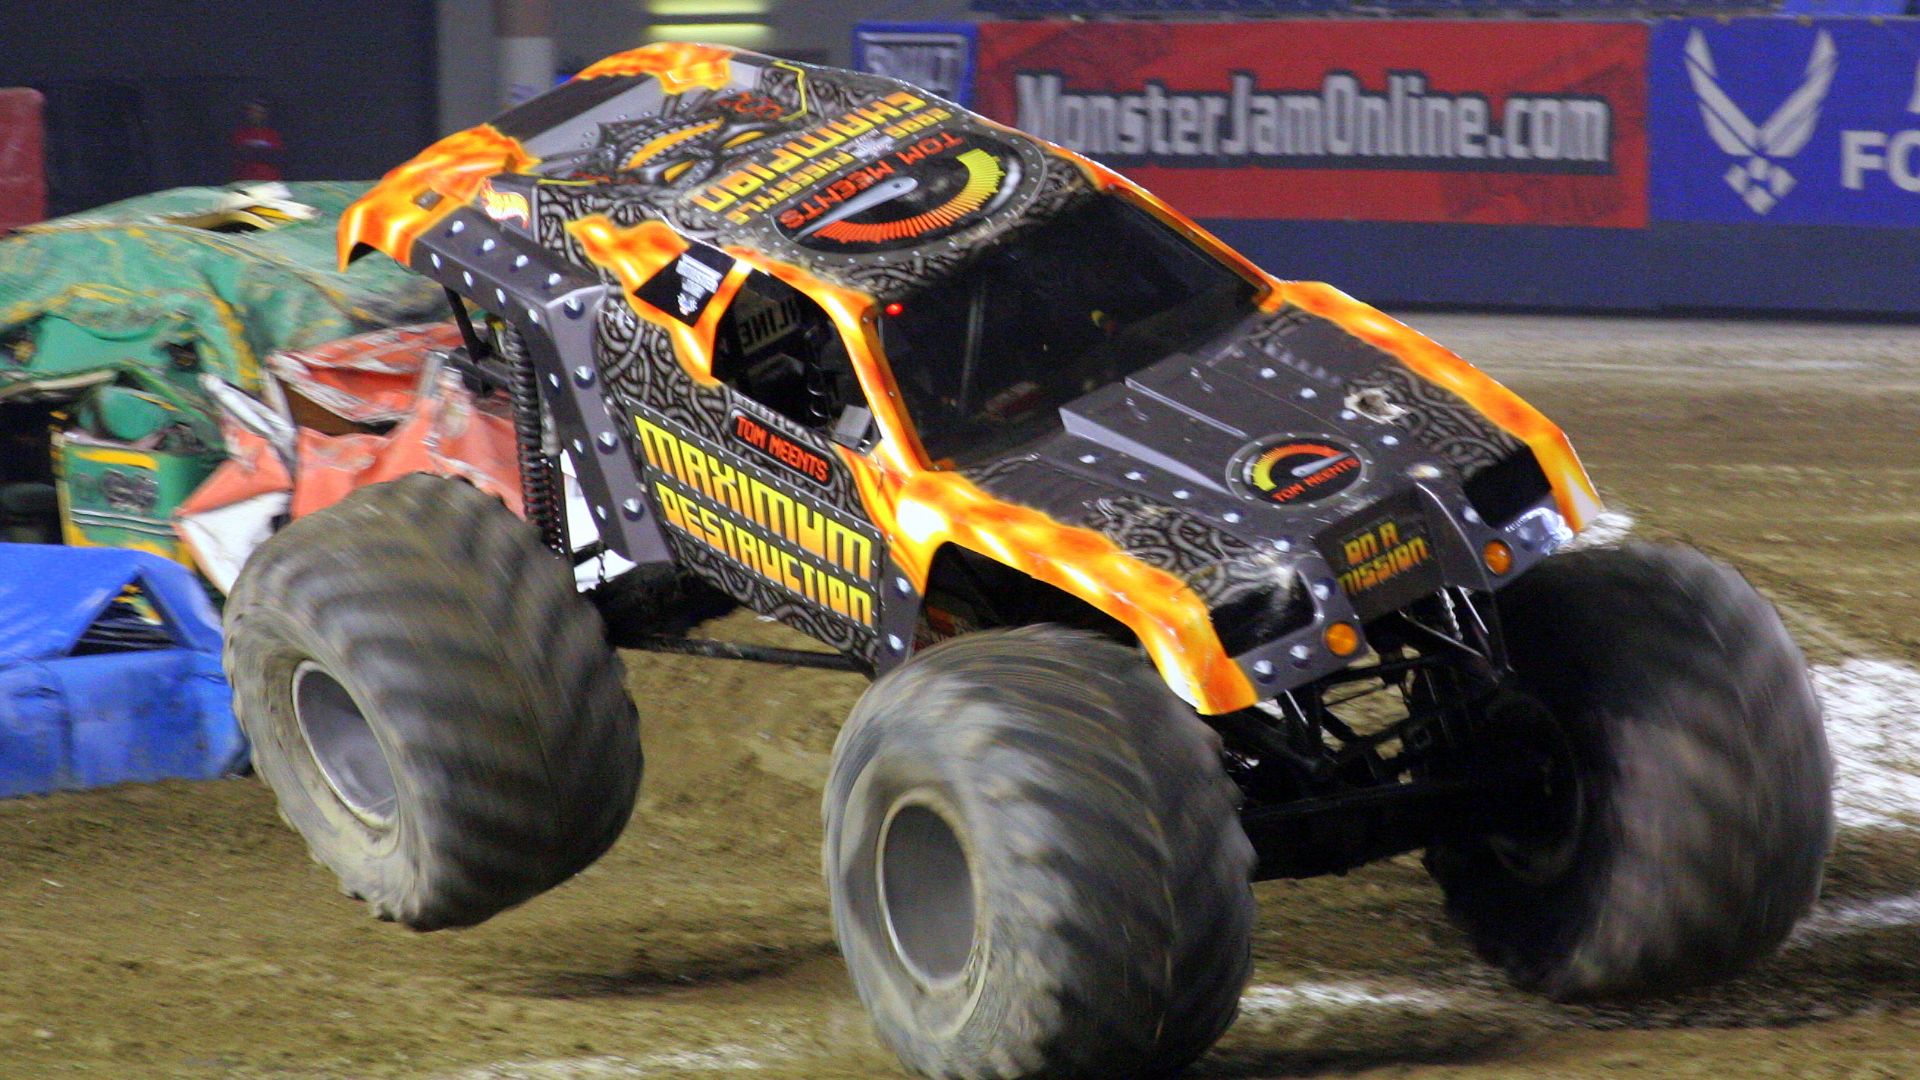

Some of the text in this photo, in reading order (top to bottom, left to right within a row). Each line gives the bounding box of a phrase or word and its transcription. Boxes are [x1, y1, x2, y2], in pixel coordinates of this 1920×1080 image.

[691, 91, 928, 212] CHAMPION
[895, 131, 966, 165] TOM
[1016, 71, 1611, 162] MonsterJamOnline.com
[724, 150, 856, 225] FREESTYLE
[778, 159, 895, 229] MEENTS
[736, 415, 829, 483] TOM MEENTS
[1271, 457, 1360, 503] TOM MEENTS
[634, 414, 873, 581] MAXIMUM
[655, 481, 873, 628] DESTRUCTION
[1343, 521, 1399, 566] ON A
